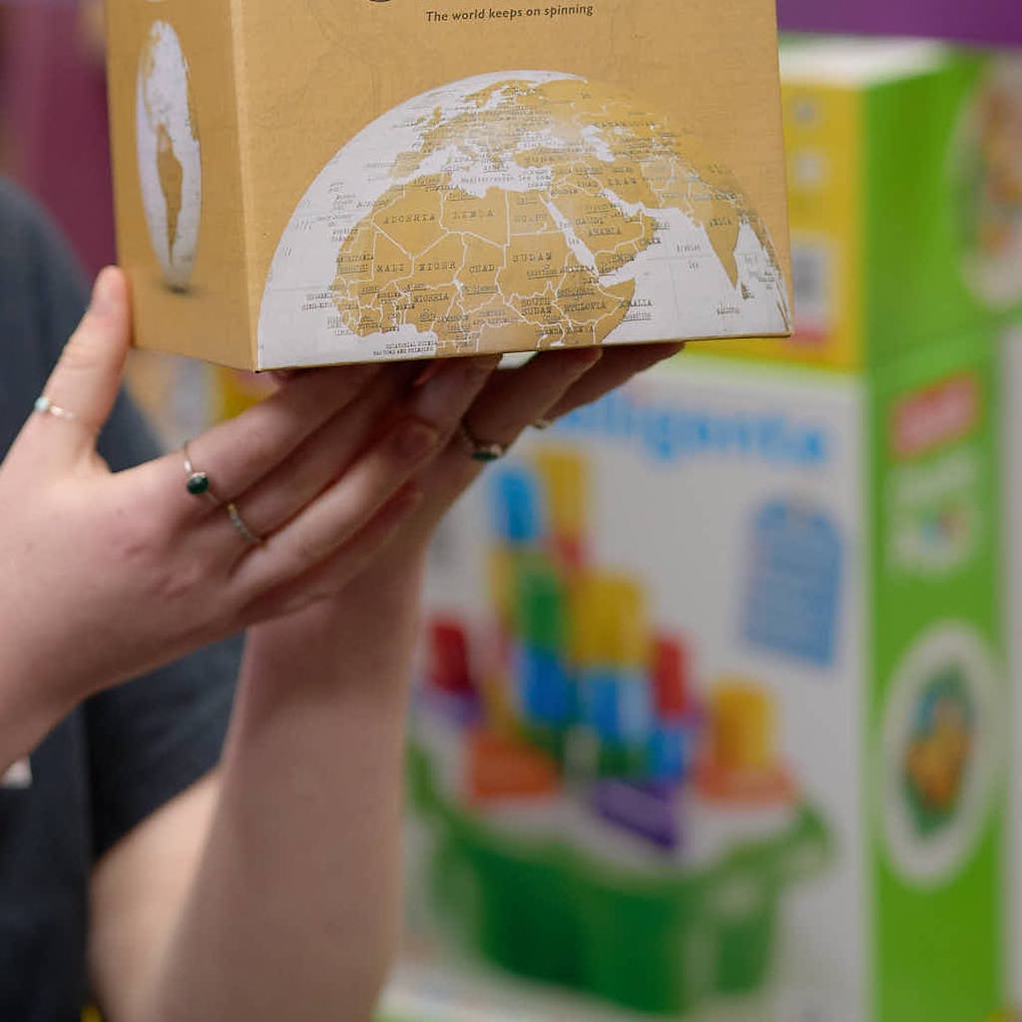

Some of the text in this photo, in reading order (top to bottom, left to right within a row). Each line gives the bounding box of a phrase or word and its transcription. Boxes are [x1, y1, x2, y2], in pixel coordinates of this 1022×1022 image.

[426, 4, 594, 22] The world keeps on spinning
[383, 214, 436, 225] ALGERIA
[512, 253, 553, 264] SUDAN
[419, 262, 457, 272] NIGER
[469, 263, 495, 274] CHAD
